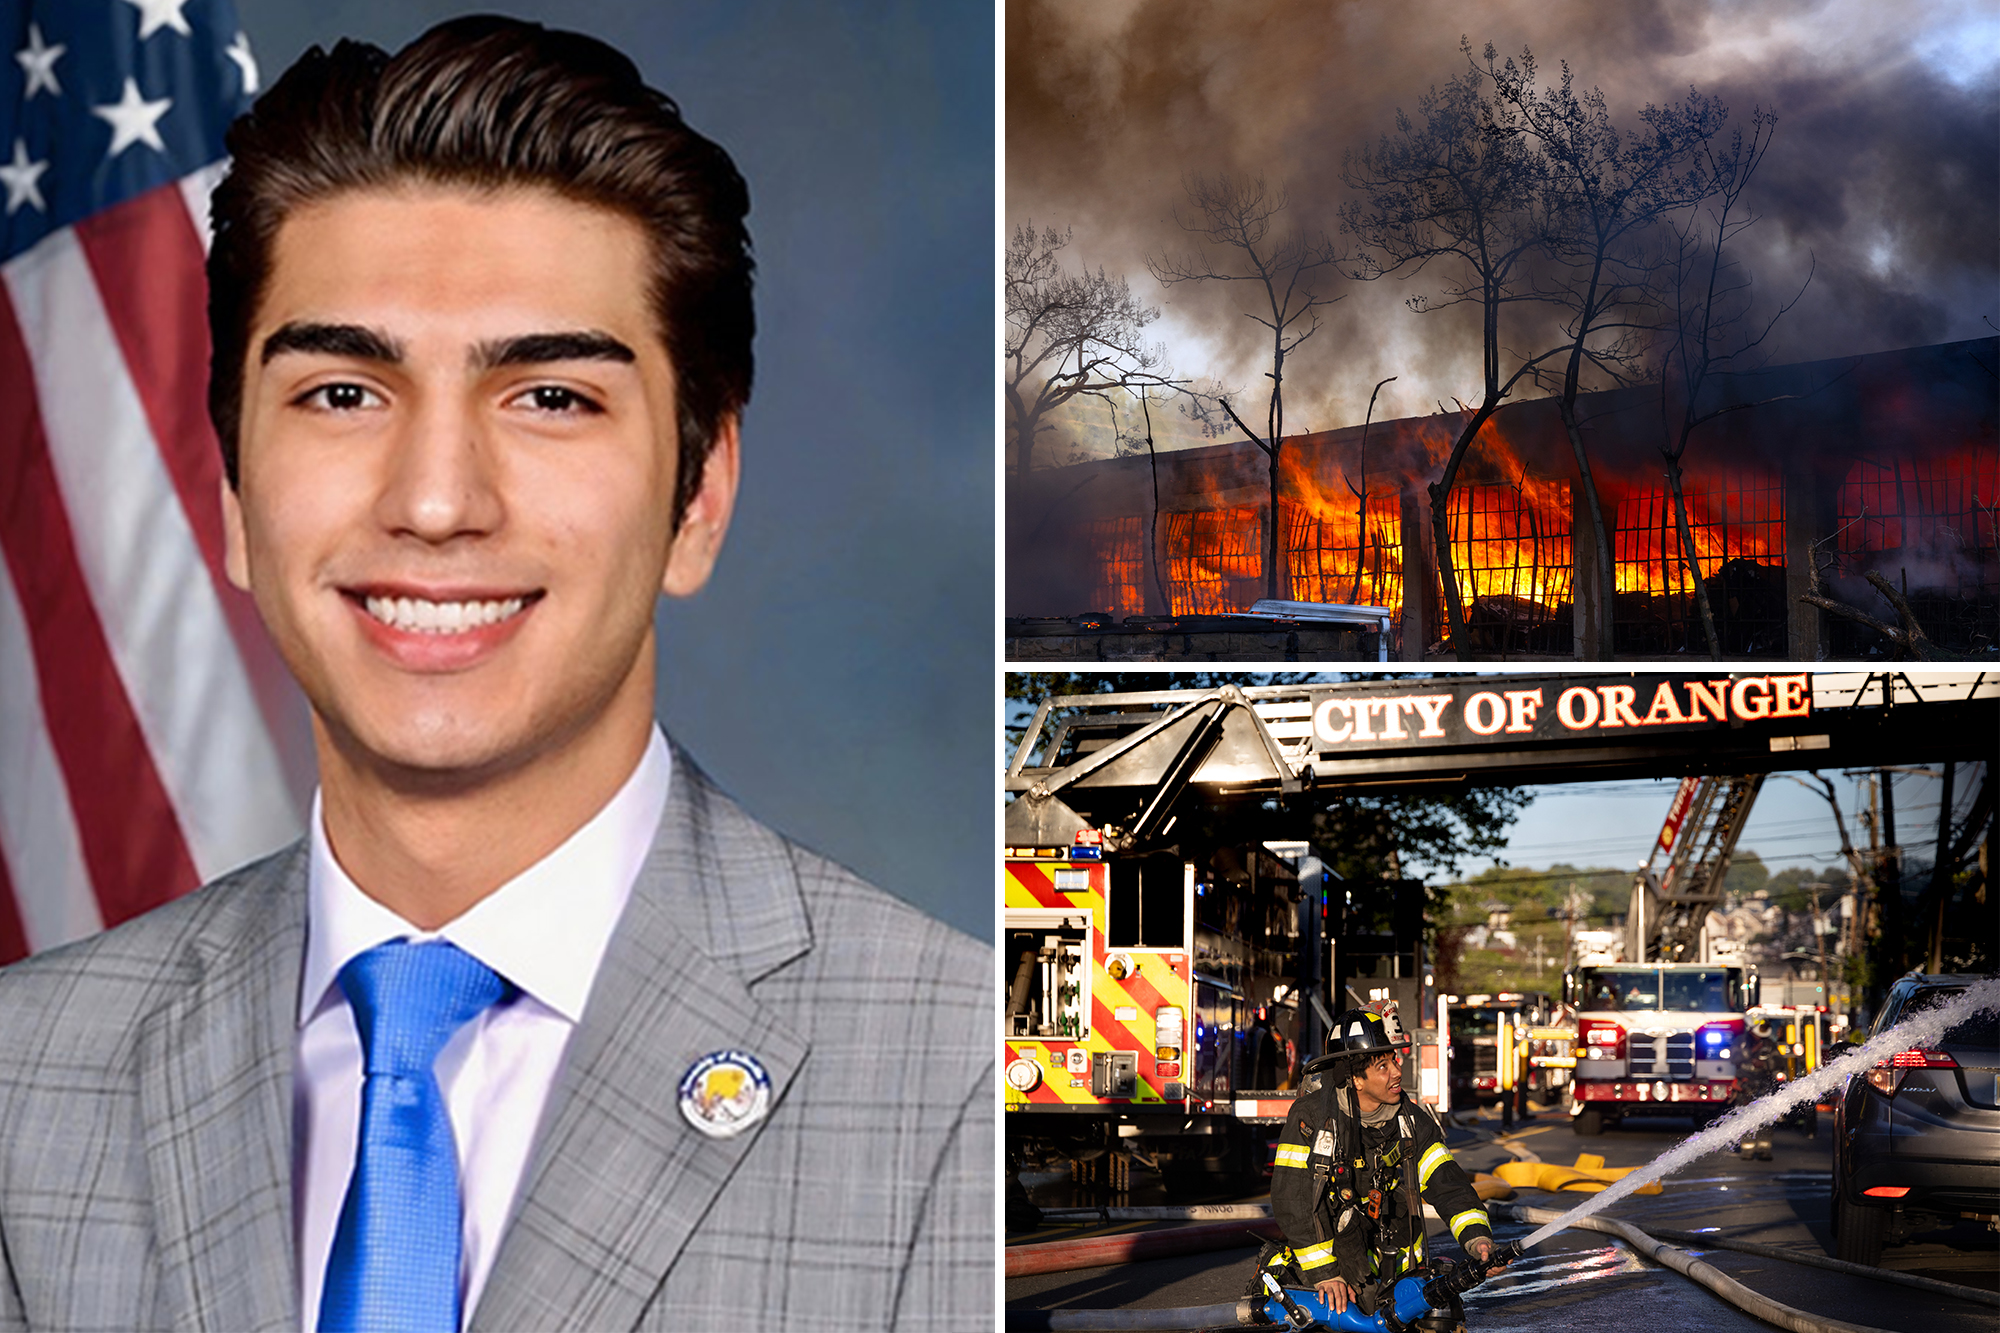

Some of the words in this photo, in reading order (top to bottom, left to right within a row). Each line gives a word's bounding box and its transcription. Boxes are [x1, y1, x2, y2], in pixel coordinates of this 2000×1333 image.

[1314, 694, 1453, 743] CITY
[1463, 687, 1543, 736] OF
[1556, 672, 1811, 731] ORANGE
[1392, 1015, 1404, 1034] 3
[1652, 1037, 1670, 1073] 1
[1636, 1083, 1650, 1101] T
